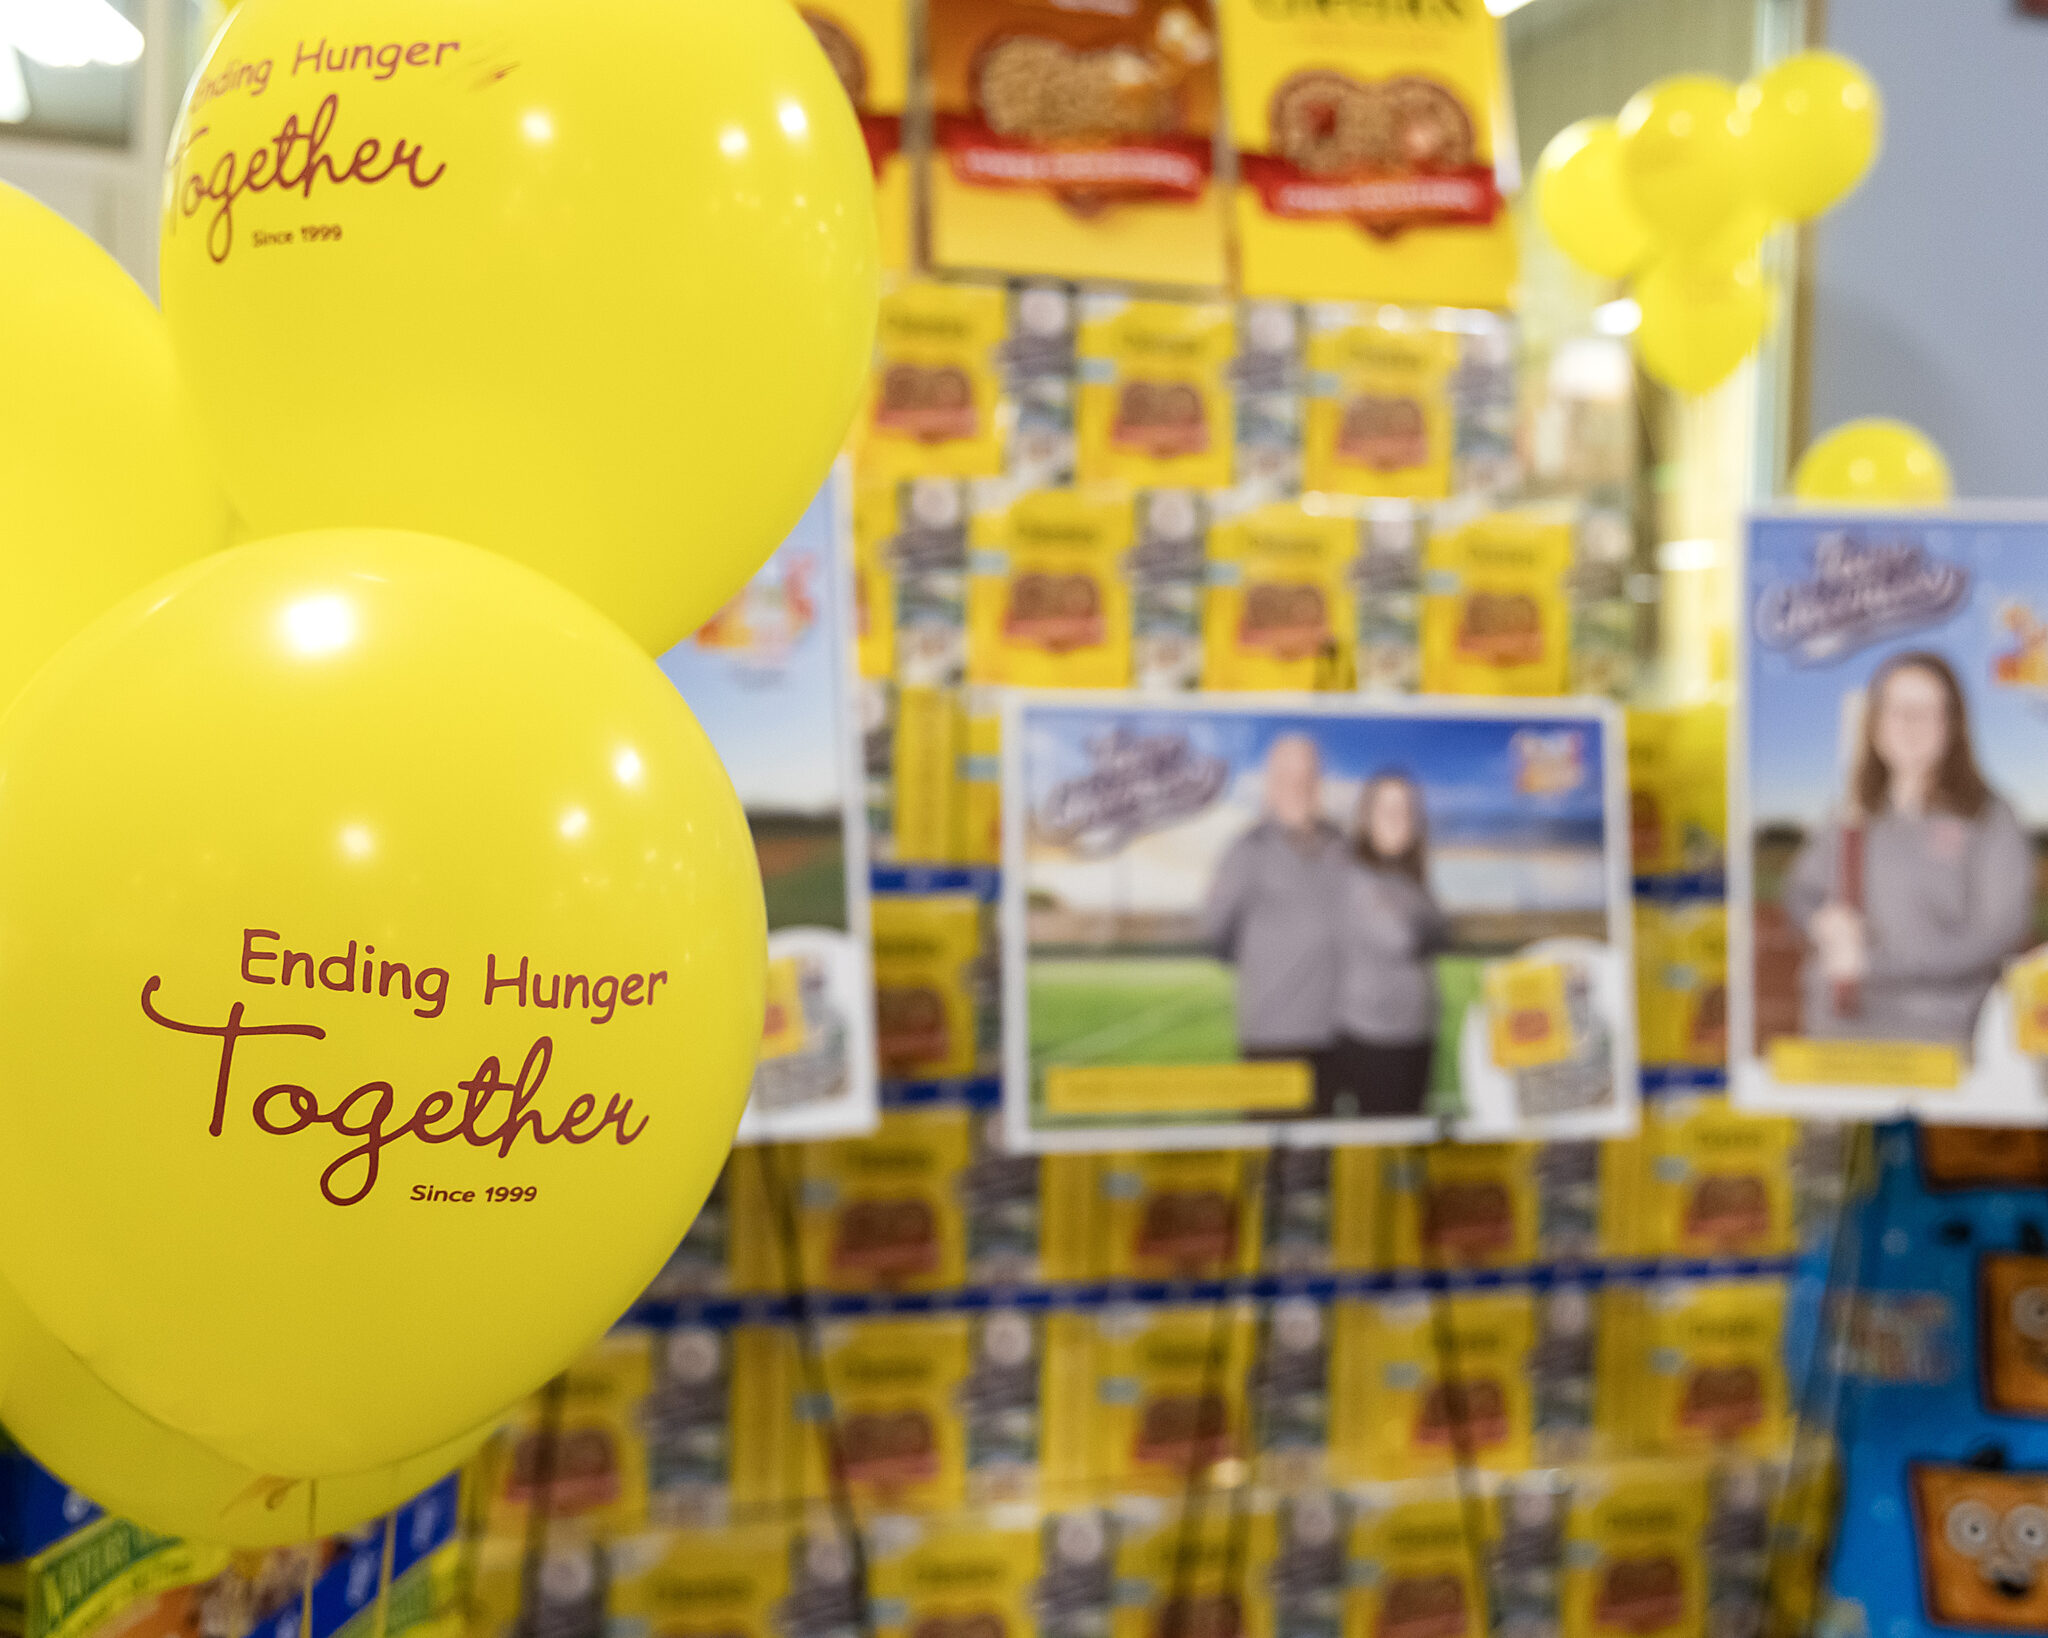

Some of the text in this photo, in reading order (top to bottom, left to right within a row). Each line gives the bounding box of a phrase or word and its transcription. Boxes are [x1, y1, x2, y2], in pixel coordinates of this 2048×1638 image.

[291, 37, 460, 81] Hunger
[169, 92, 447, 265] Together
[252, 224, 343, 247] Since 1999
[240, 927, 668, 1025] Ending Hunger
[140, 974, 650, 1207] Together
[409, 1184, 538, 1203] Since 1999
